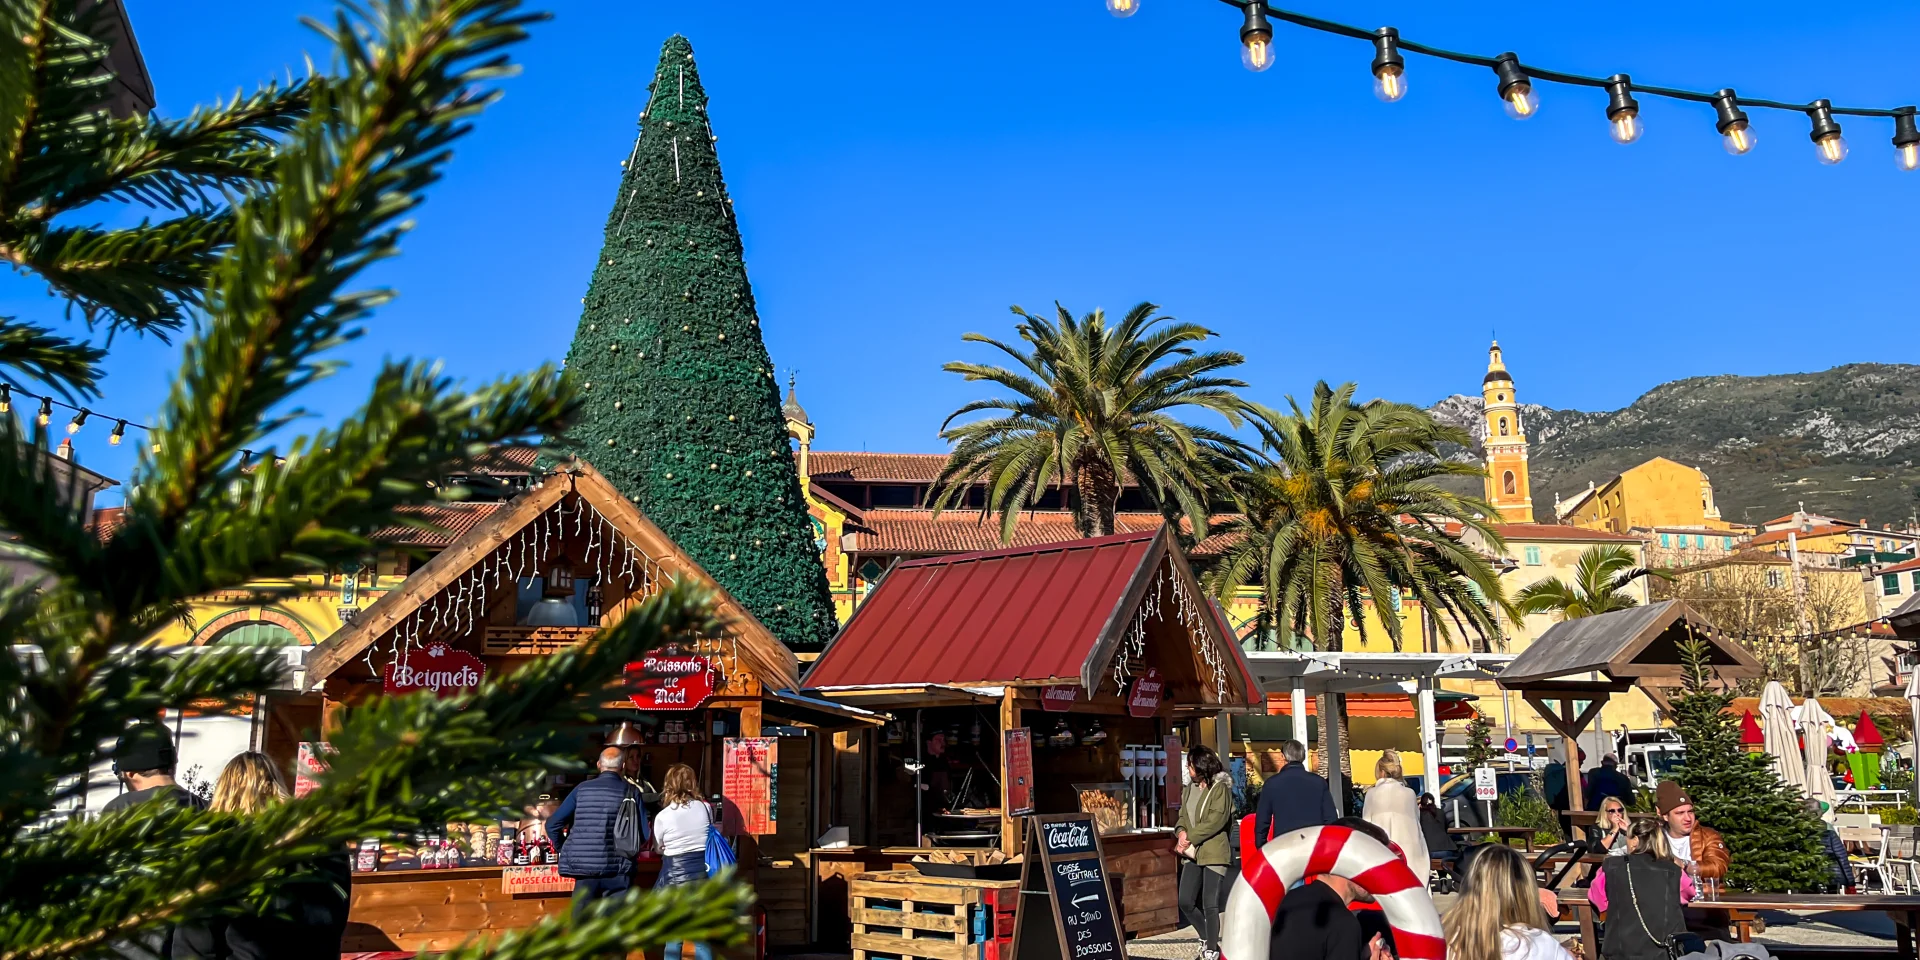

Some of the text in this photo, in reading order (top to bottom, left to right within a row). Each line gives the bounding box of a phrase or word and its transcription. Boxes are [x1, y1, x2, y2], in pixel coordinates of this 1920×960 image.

[643, 657, 702, 672] Boissons
[395, 665, 479, 692] Beignets
[654, 688, 686, 704] Noël
[1045, 686, 1077, 701] allemande
[1049, 826, 1089, 849] Coca-Cola
[1057, 863, 1080, 875] CAISSE
[1068, 869, 1100, 880] CENTRALE
[510, 875, 576, 885] CAISSE CENTRA
[1067, 910, 1101, 926] AU STAND
[1077, 928, 1092, 941] DES
[1076, 942, 1113, 958] BOISSONS
